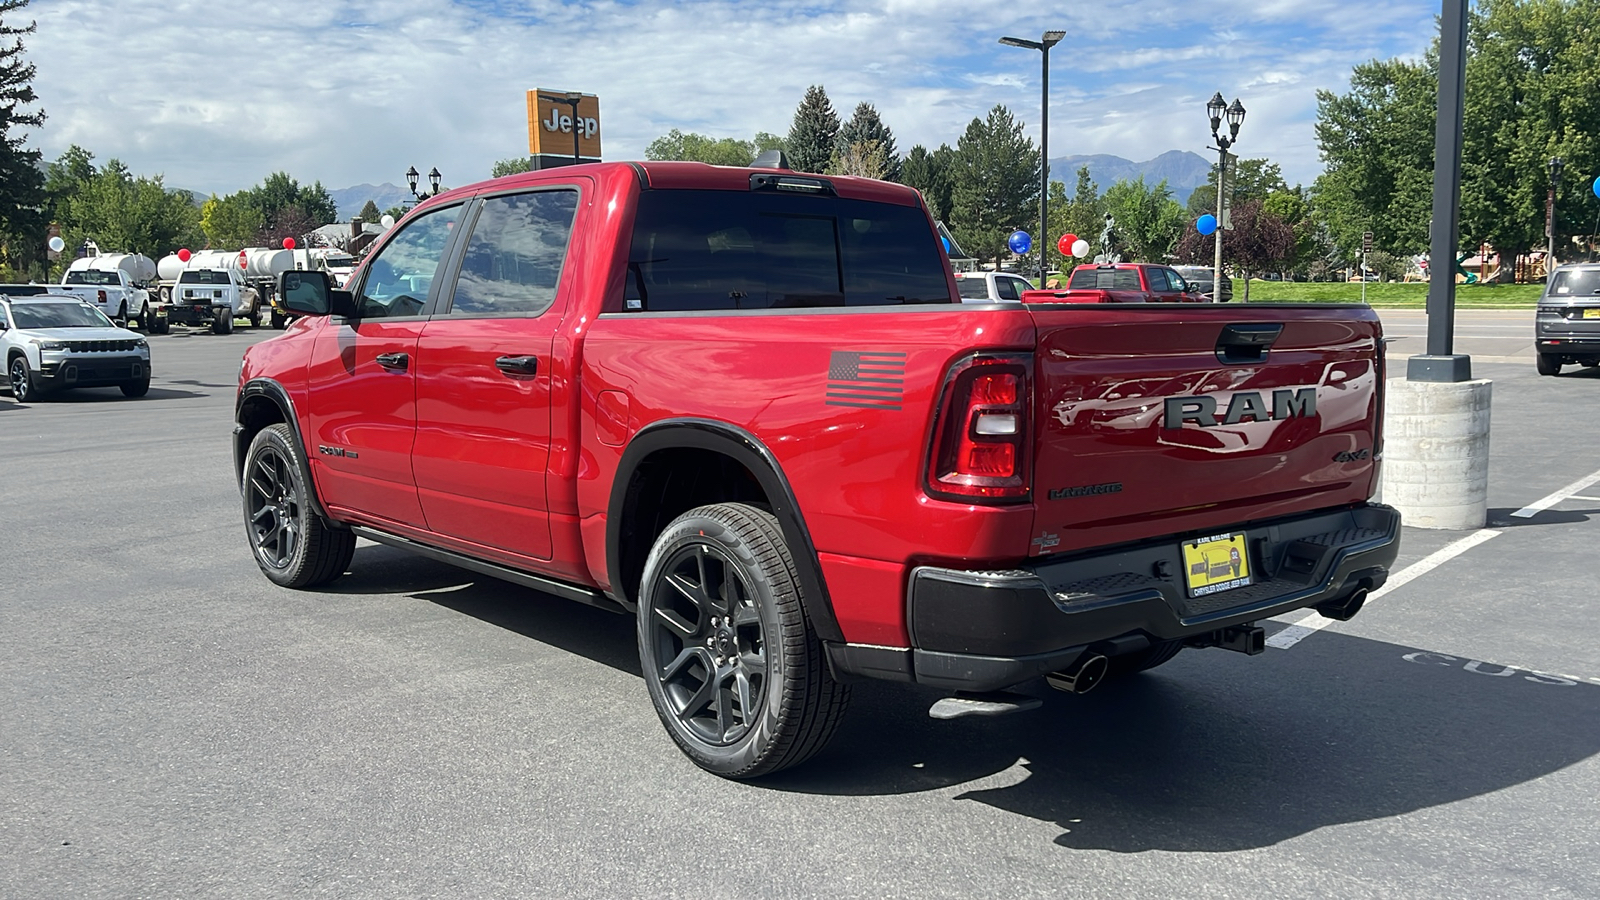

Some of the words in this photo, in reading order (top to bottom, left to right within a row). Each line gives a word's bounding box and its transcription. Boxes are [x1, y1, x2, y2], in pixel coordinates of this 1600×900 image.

[543, 108, 598, 139] Jeep
[1164, 387, 1317, 430] RAM
[319, 444, 346, 458] RAM
[1048, 482, 1123, 500] LARAMIE
[1211, 533, 1230, 542] MALONE
[1194, 585, 1216, 596] CHRYSLER
[1215, 581, 1231, 592] DODGE
[1230, 579, 1241, 588] JEEP
[1401, 651, 1600, 686] CUS
